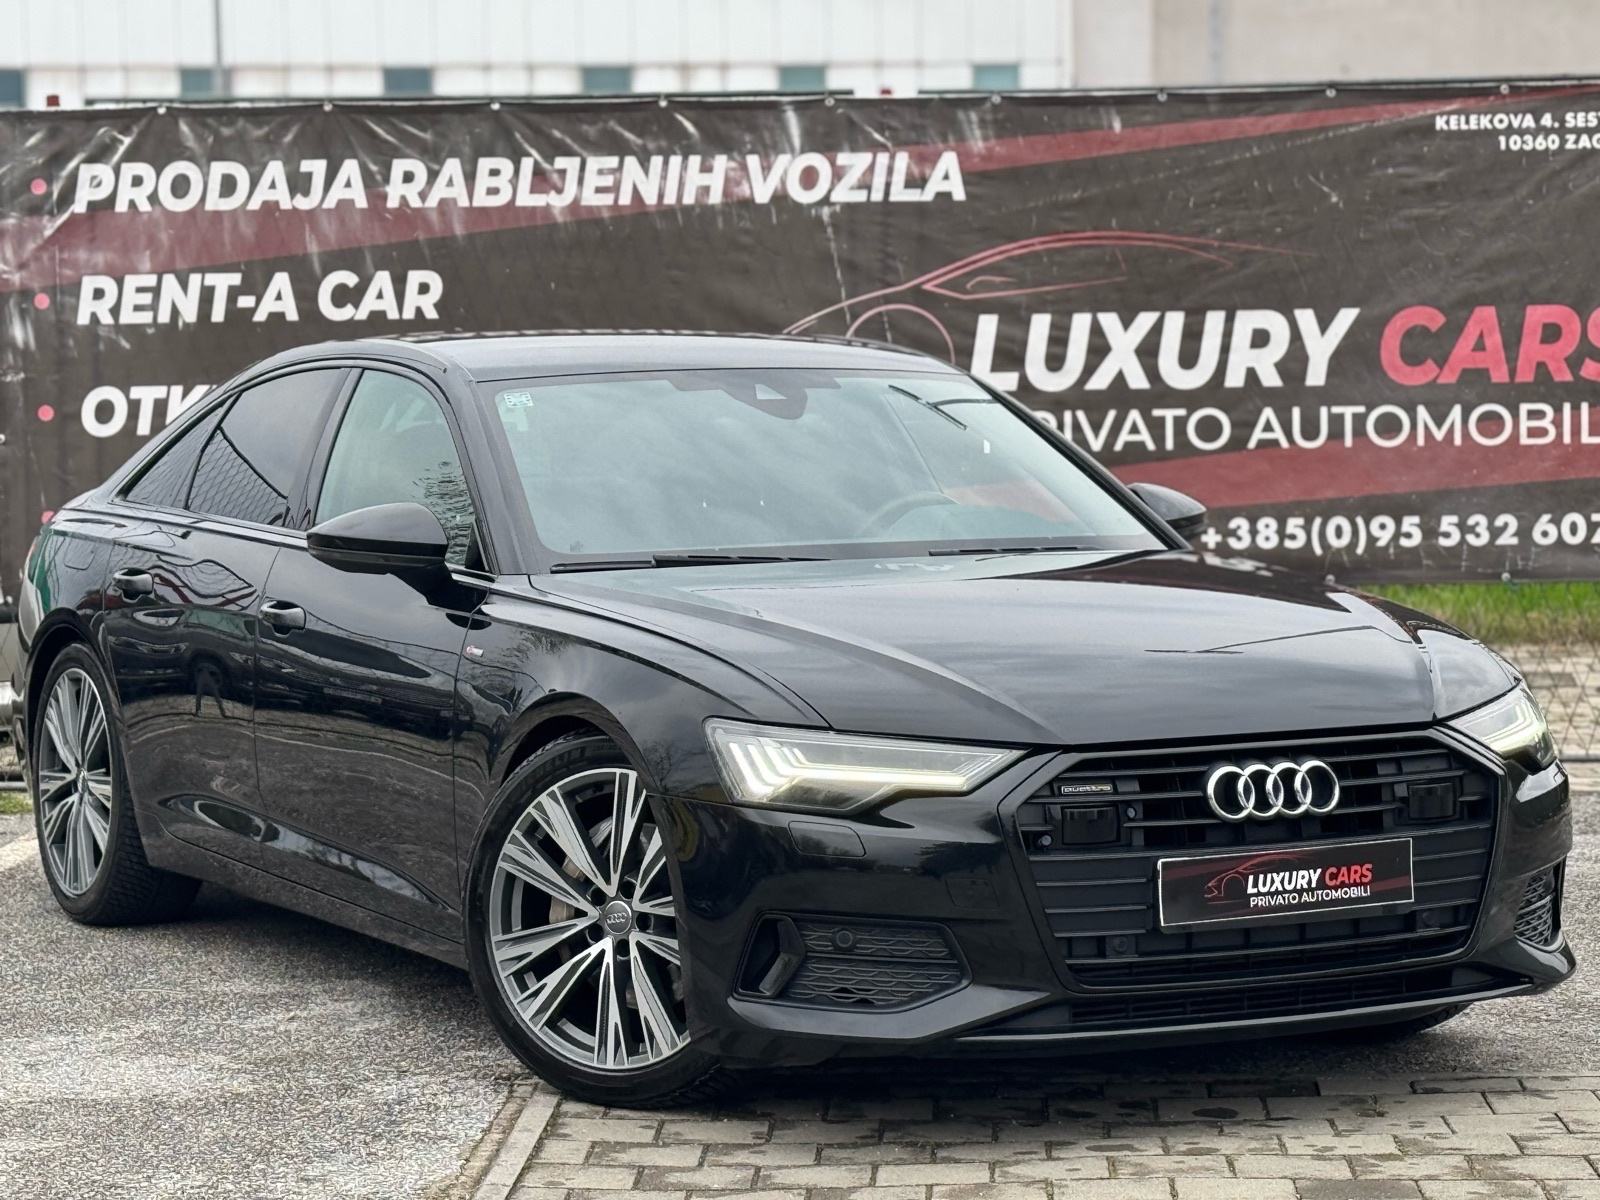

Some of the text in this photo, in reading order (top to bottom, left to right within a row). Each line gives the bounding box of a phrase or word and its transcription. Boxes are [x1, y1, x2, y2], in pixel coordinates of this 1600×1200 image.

[1435, 113, 1536, 131] KELEKOVA
[1498, 134, 1560, 151] 10360
[73, 151, 967, 214] PRODAJA RABLJENIH VOZILA
[77, 270, 444, 325] RENT-A CAR
[970, 307, 1361, 393] LUXURY
[81, 384, 218, 438] OTK
[1246, 401, 1600, 451] AUTOMOBIL
[1201, 514, 1423, 557] +385(0)95
[1438, 513, 1519, 548] 532
[1246, 863, 1373, 894] LUXURY CARS
[1250, 885, 1371, 908] PRIVATO AUTOMOBILI
